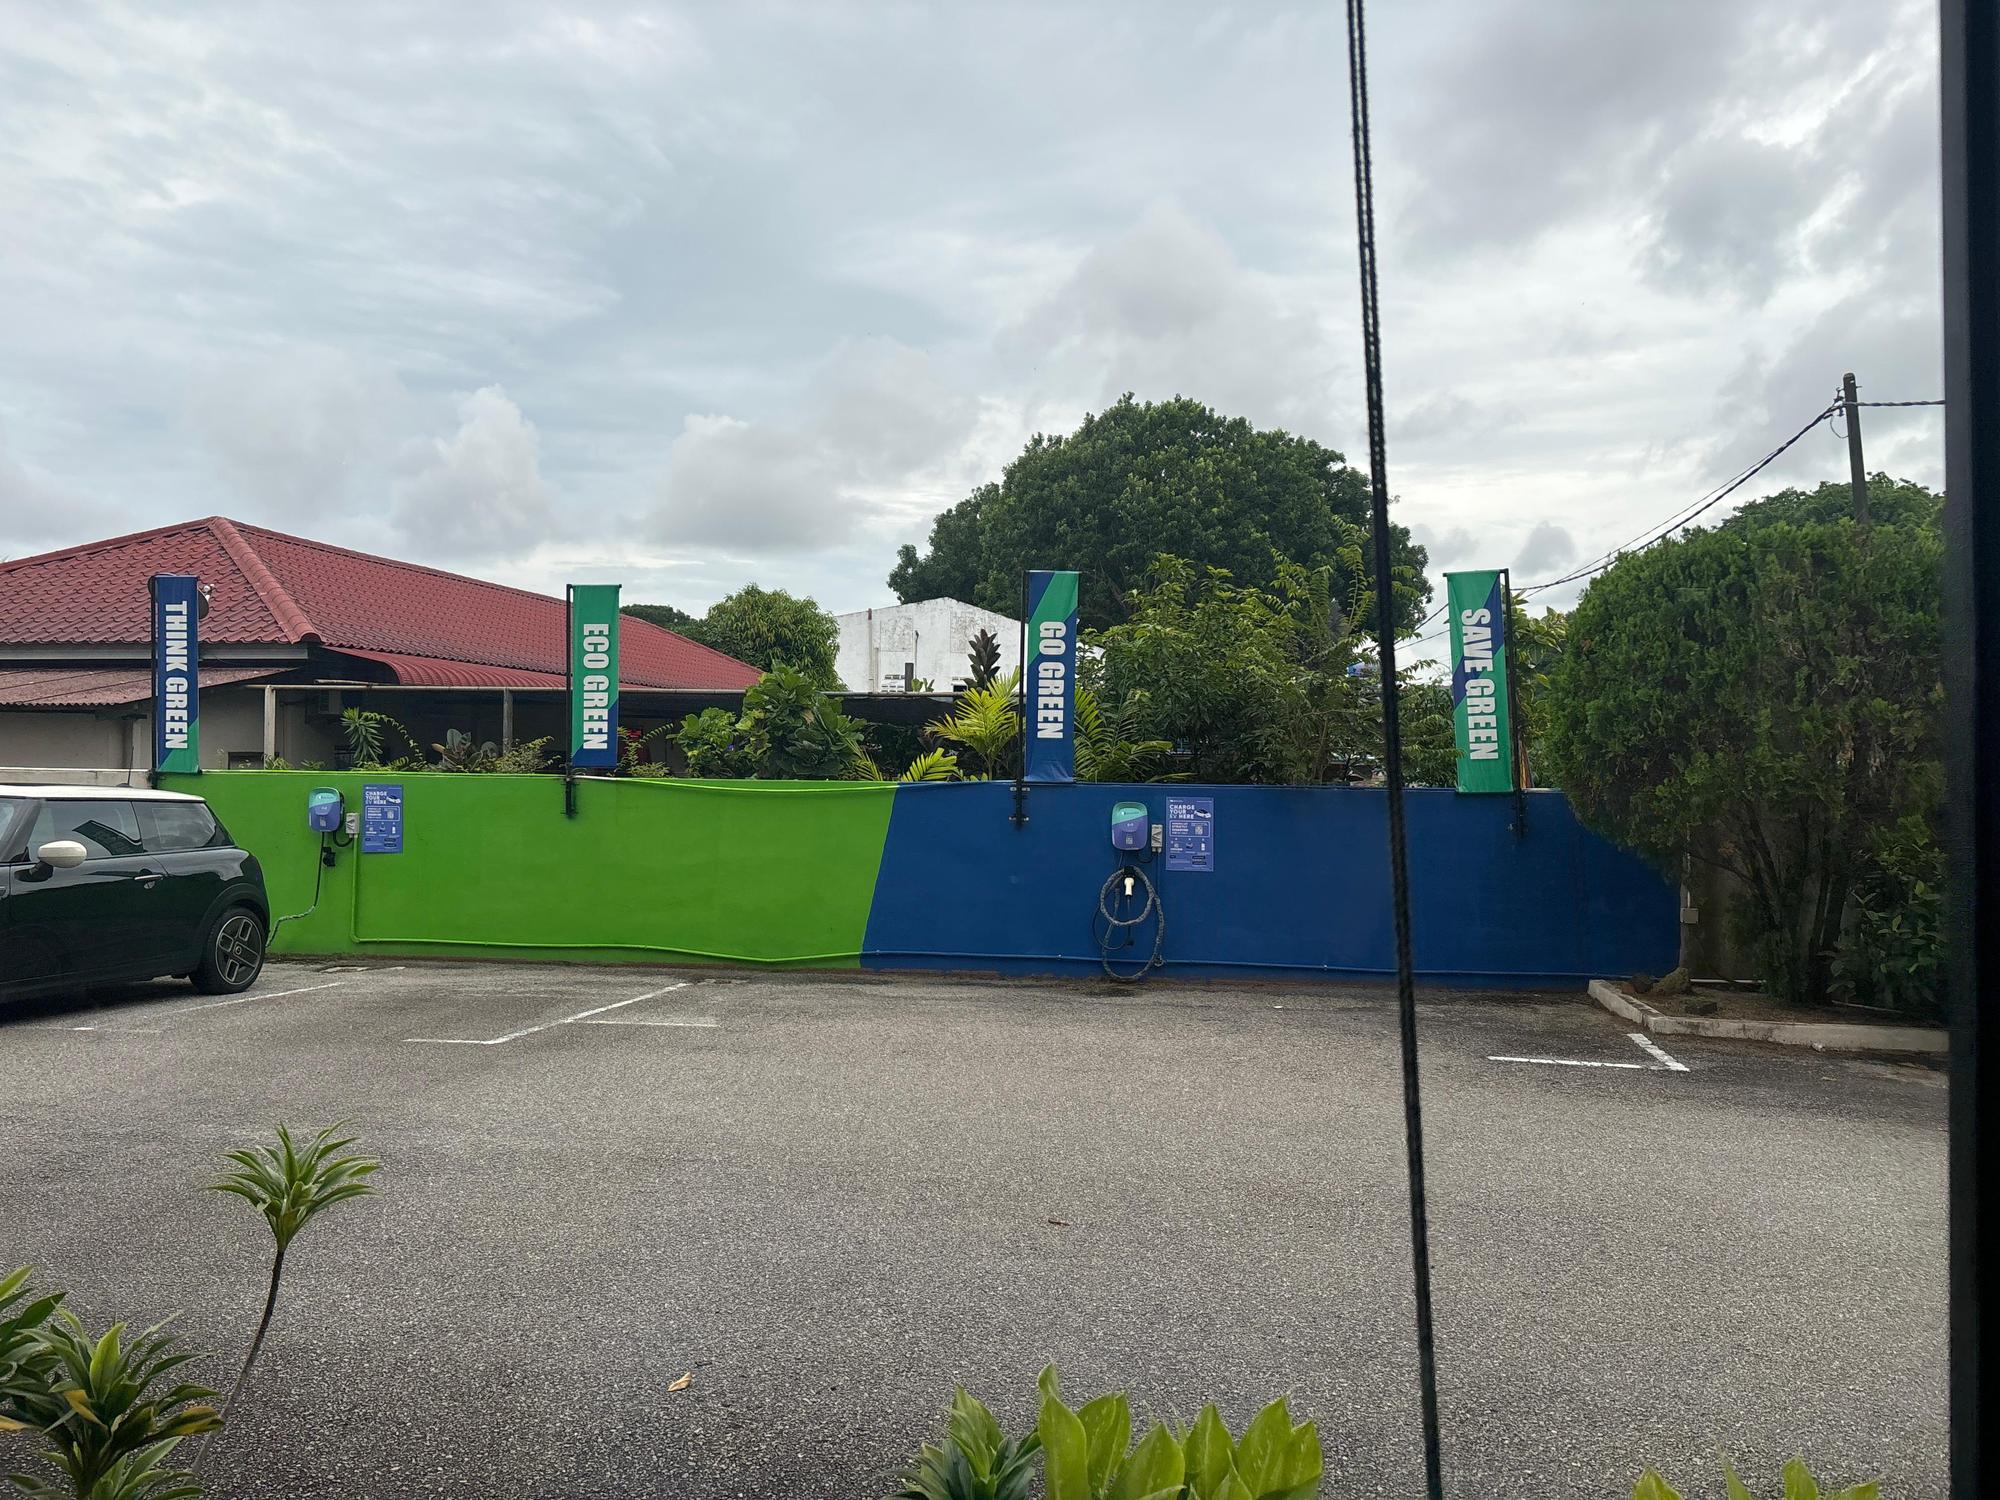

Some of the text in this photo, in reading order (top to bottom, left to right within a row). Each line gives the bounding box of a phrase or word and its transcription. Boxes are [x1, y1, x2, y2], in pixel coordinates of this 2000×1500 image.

[165, 600, 188, 749] THINK GREEN
[583, 623, 610, 749] ECO GREEN
[1037, 621, 1067, 739] GO GREEN
[1461, 608, 1499, 760] SAVE GREEN
